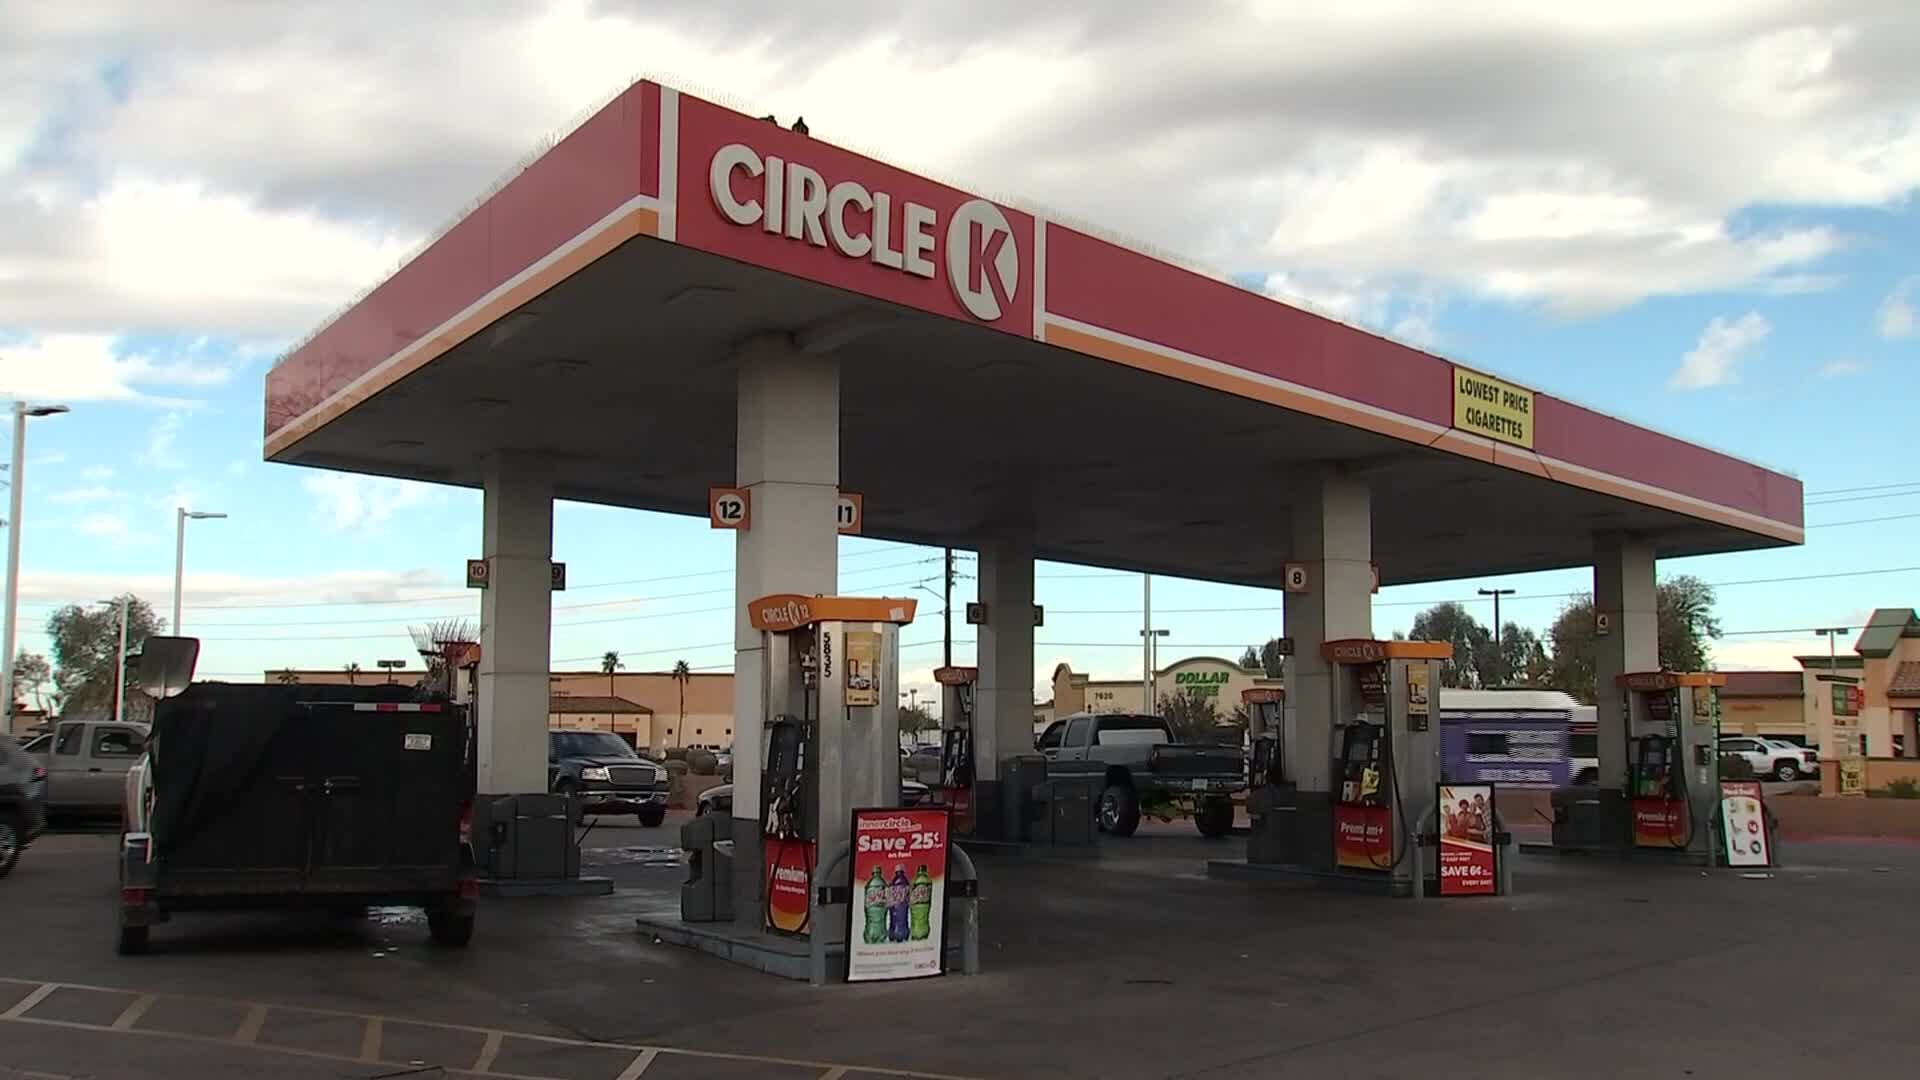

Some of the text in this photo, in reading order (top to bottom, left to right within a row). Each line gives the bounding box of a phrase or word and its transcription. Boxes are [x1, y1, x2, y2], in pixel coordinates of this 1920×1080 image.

[708, 143, 937, 280] CIRCLE
[1459, 375, 1528, 414] LOWEST PRICE
[1466, 407, 1522, 439] CIGARETTES
[719, 501, 741, 519] 12
[838, 505, 853, 523] 11
[472, 566, 484, 578] 10
[552, 567, 561, 578] 9
[1293, 571, 1302, 585] 8
[762, 607, 789, 624] CIRCLE
[1175, 671, 1230, 684] DOLLAR
[1186, 685, 1220, 697] TREE
[858, 834, 907, 852] Save
[1441, 865, 1469, 877] SAVE
